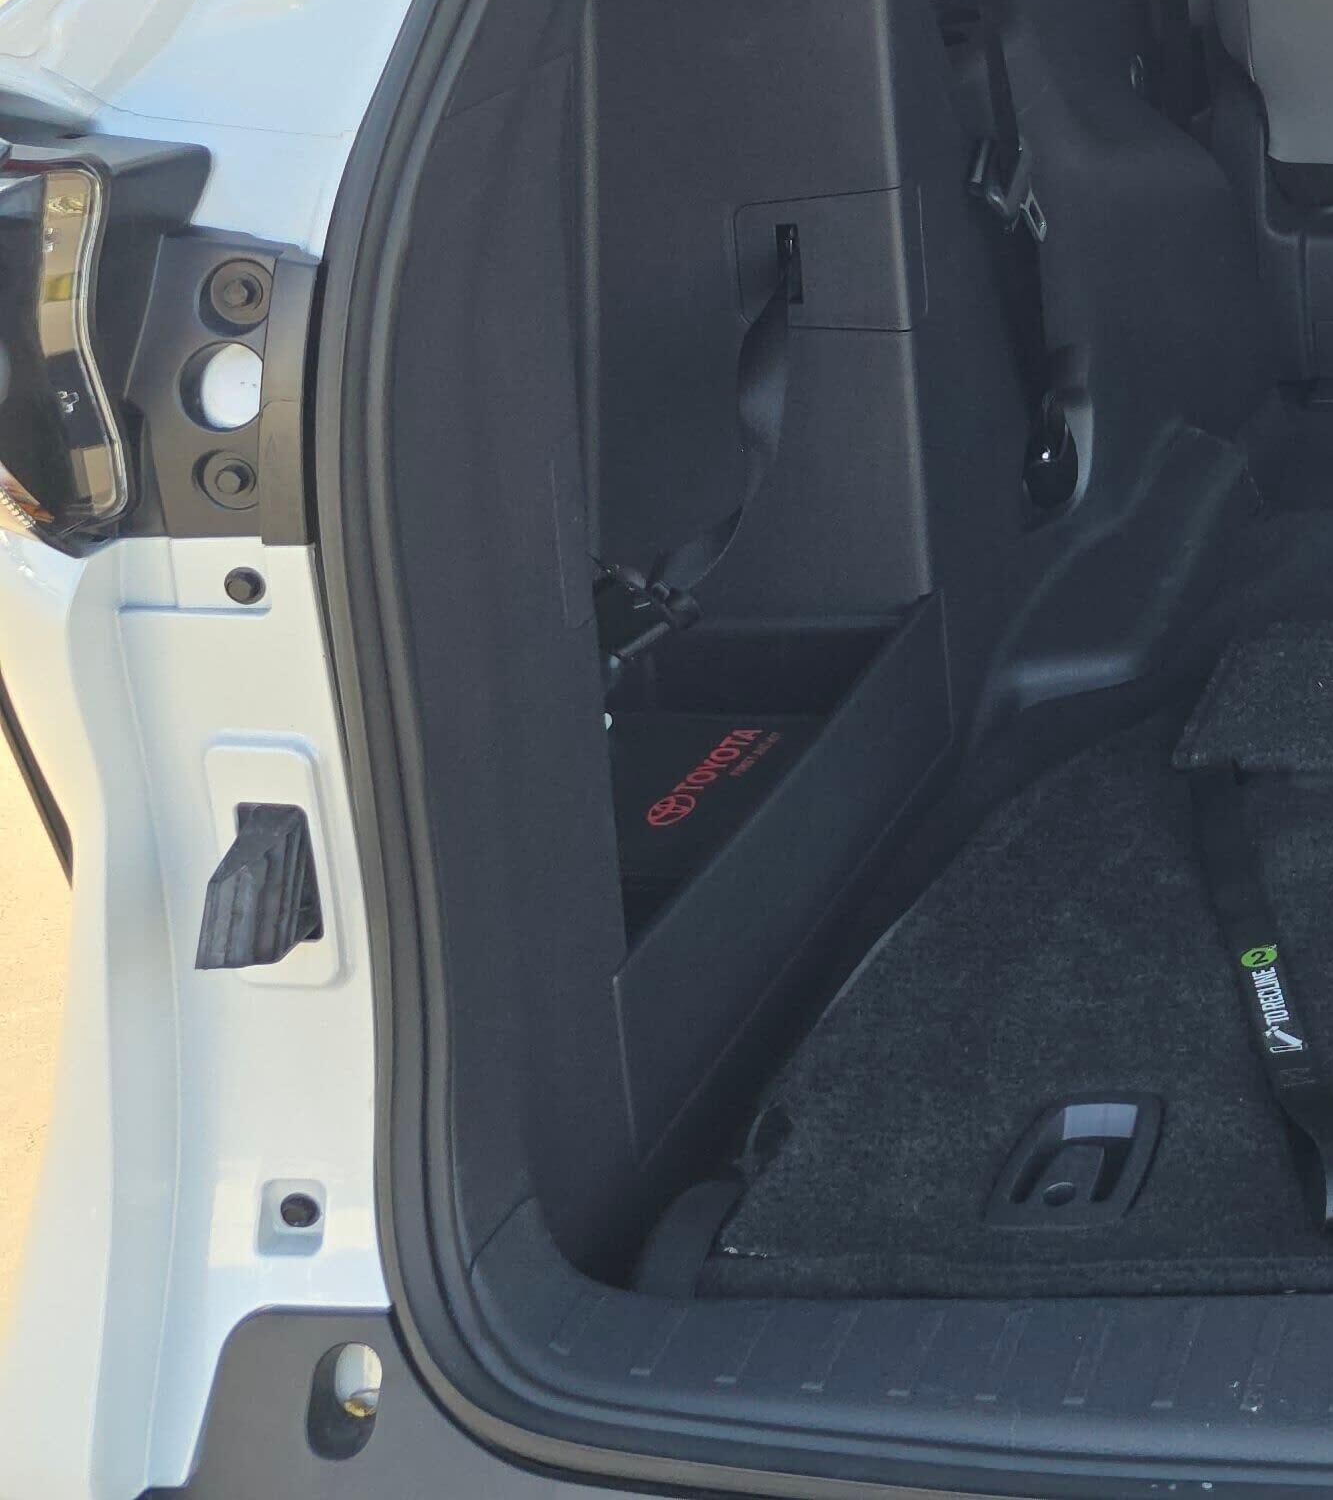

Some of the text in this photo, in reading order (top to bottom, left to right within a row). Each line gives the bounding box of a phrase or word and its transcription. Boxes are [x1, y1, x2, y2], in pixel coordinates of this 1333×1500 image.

[672, 729, 763, 793] TOYOTA
[1251, 950, 1270, 966] 2
[1252, 966, 1290, 1026] TO RECLINE
